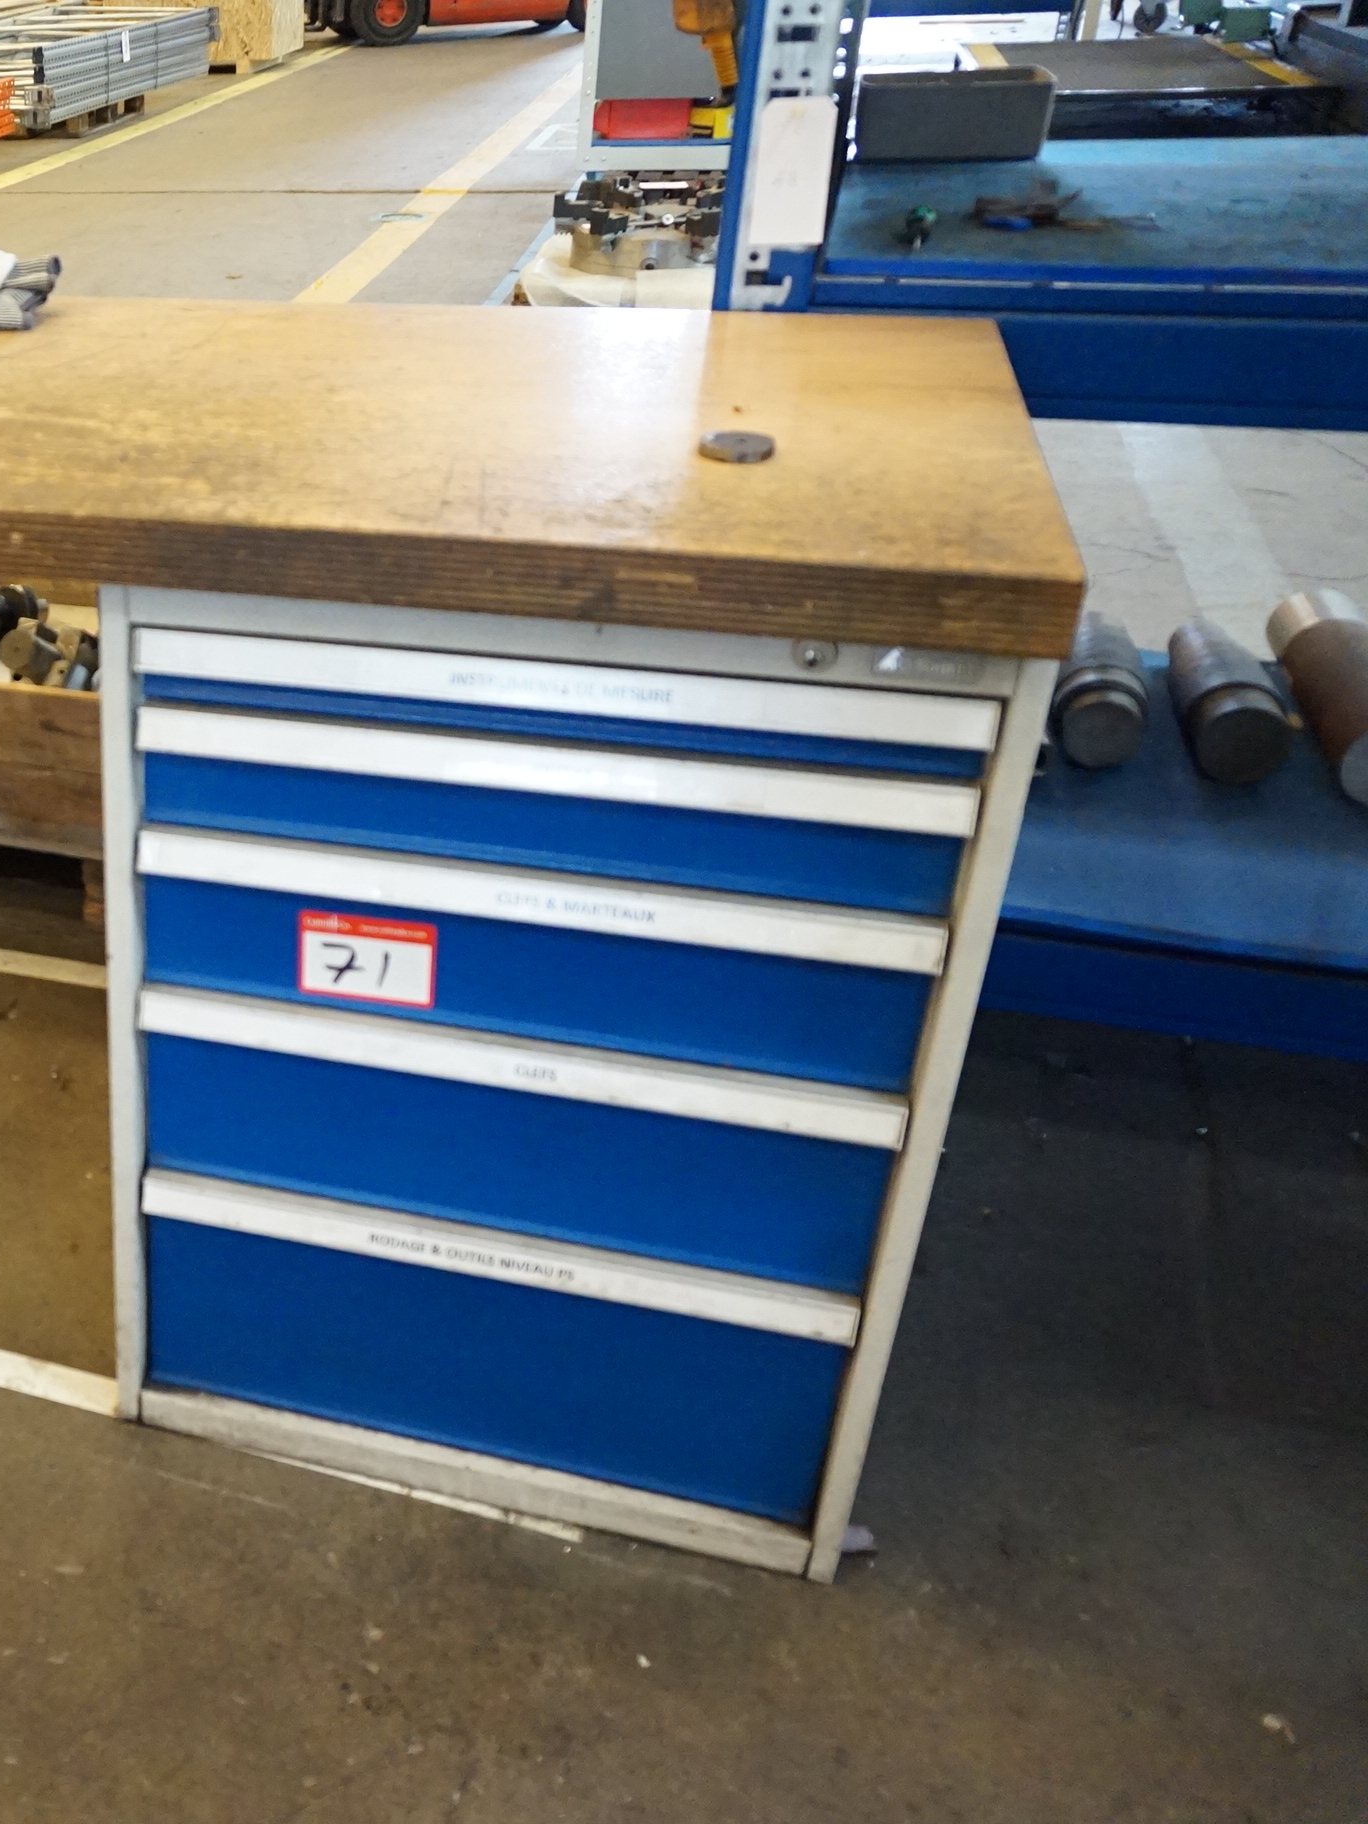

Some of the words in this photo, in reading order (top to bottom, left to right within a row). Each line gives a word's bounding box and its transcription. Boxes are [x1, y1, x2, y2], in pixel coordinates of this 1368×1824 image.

[602, 682, 674, 704] MESURE
[563, 900, 657, 924] MARTEAUX
[320, 942, 391, 988] 71
[368, 1231, 425, 1252] RODAGE
[430, 1243, 442, 1256] &
[500, 1256, 555, 1279] NIVEAU
